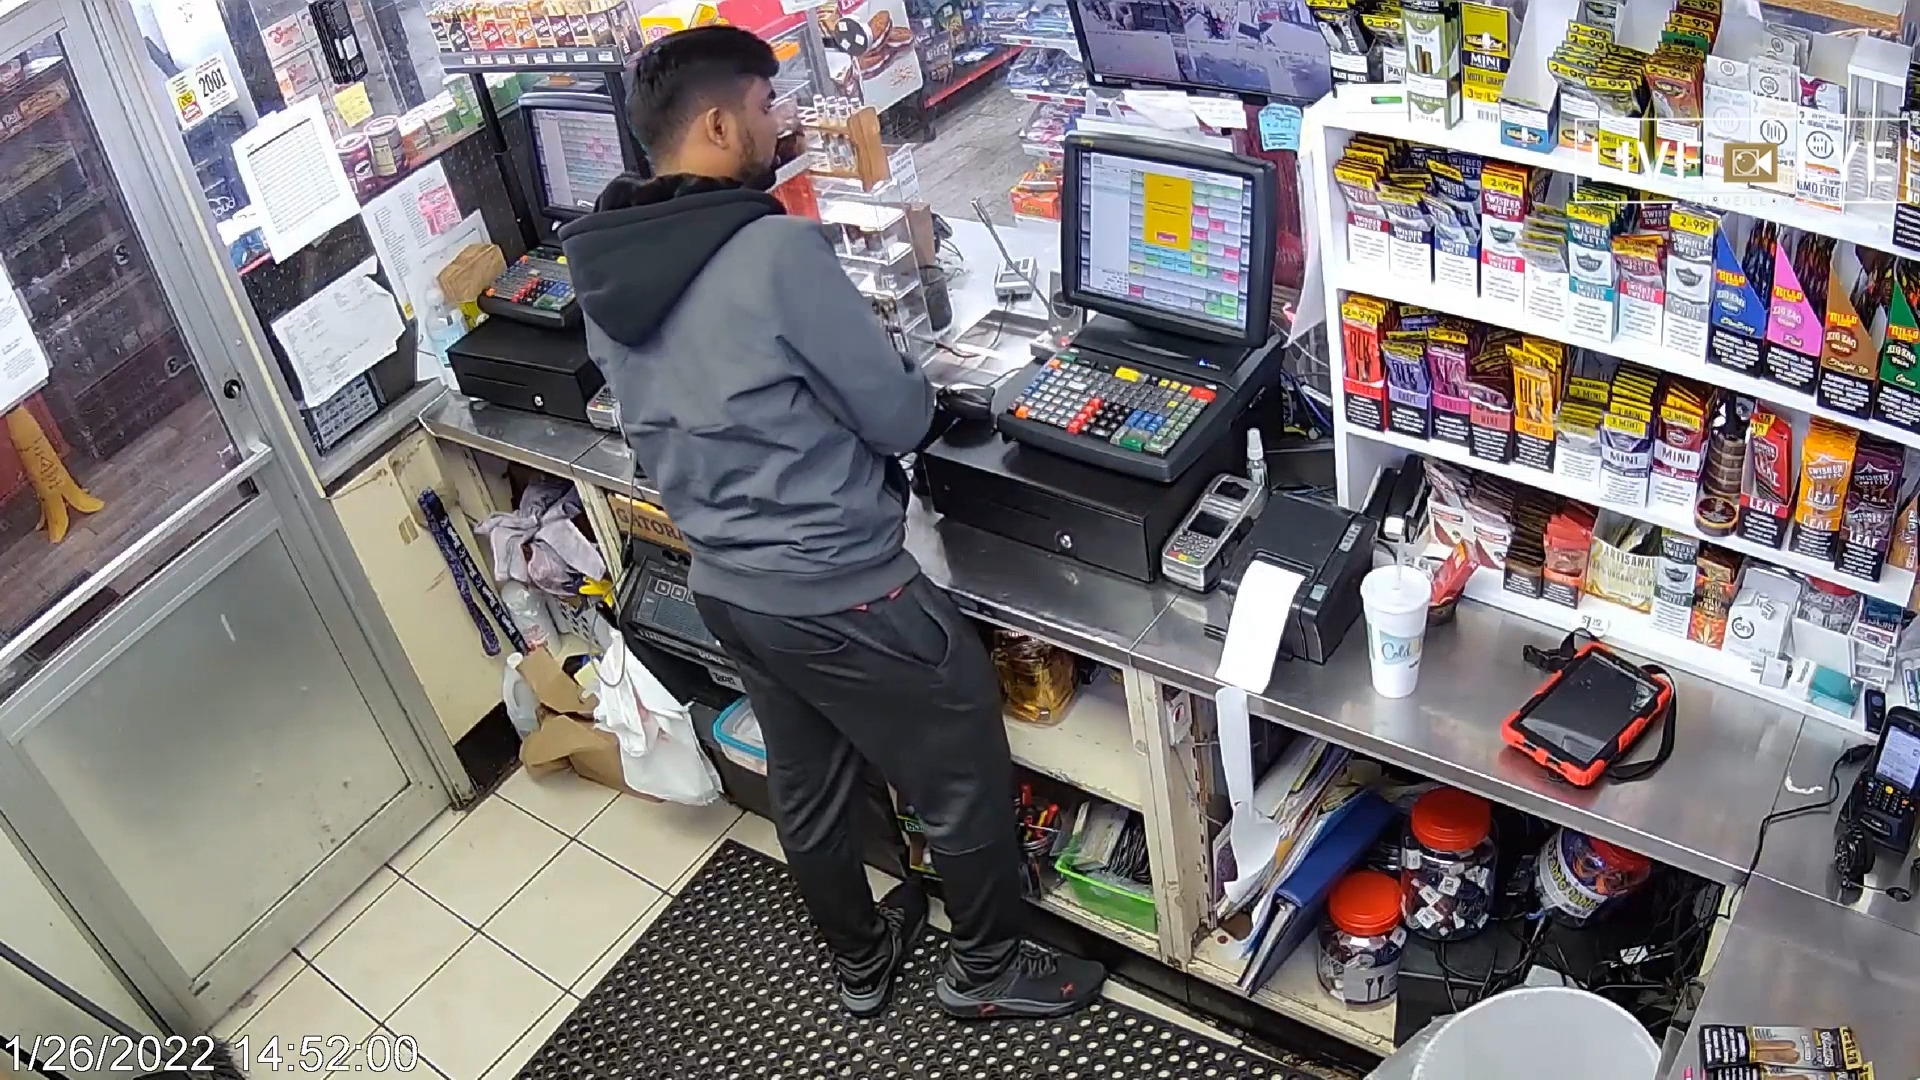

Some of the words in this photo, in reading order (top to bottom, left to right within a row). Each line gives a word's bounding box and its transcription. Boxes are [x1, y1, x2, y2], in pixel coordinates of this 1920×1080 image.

[1470, 52, 1501, 71] MINI
[198, 67, 227, 98] 2001
[1820, 183, 1840, 198] FREE
[1680, 216, 1687, 227] 2
[1608, 451, 1639, 465] MINI
[1661, 447, 1691, 464] MINI
[1807, 487, 1840, 506] LEAF
[1749, 498, 1780, 516] LEAF
[1849, 528, 1881, 549] LEAF
[1381, 642, 1411, 660] Cold
